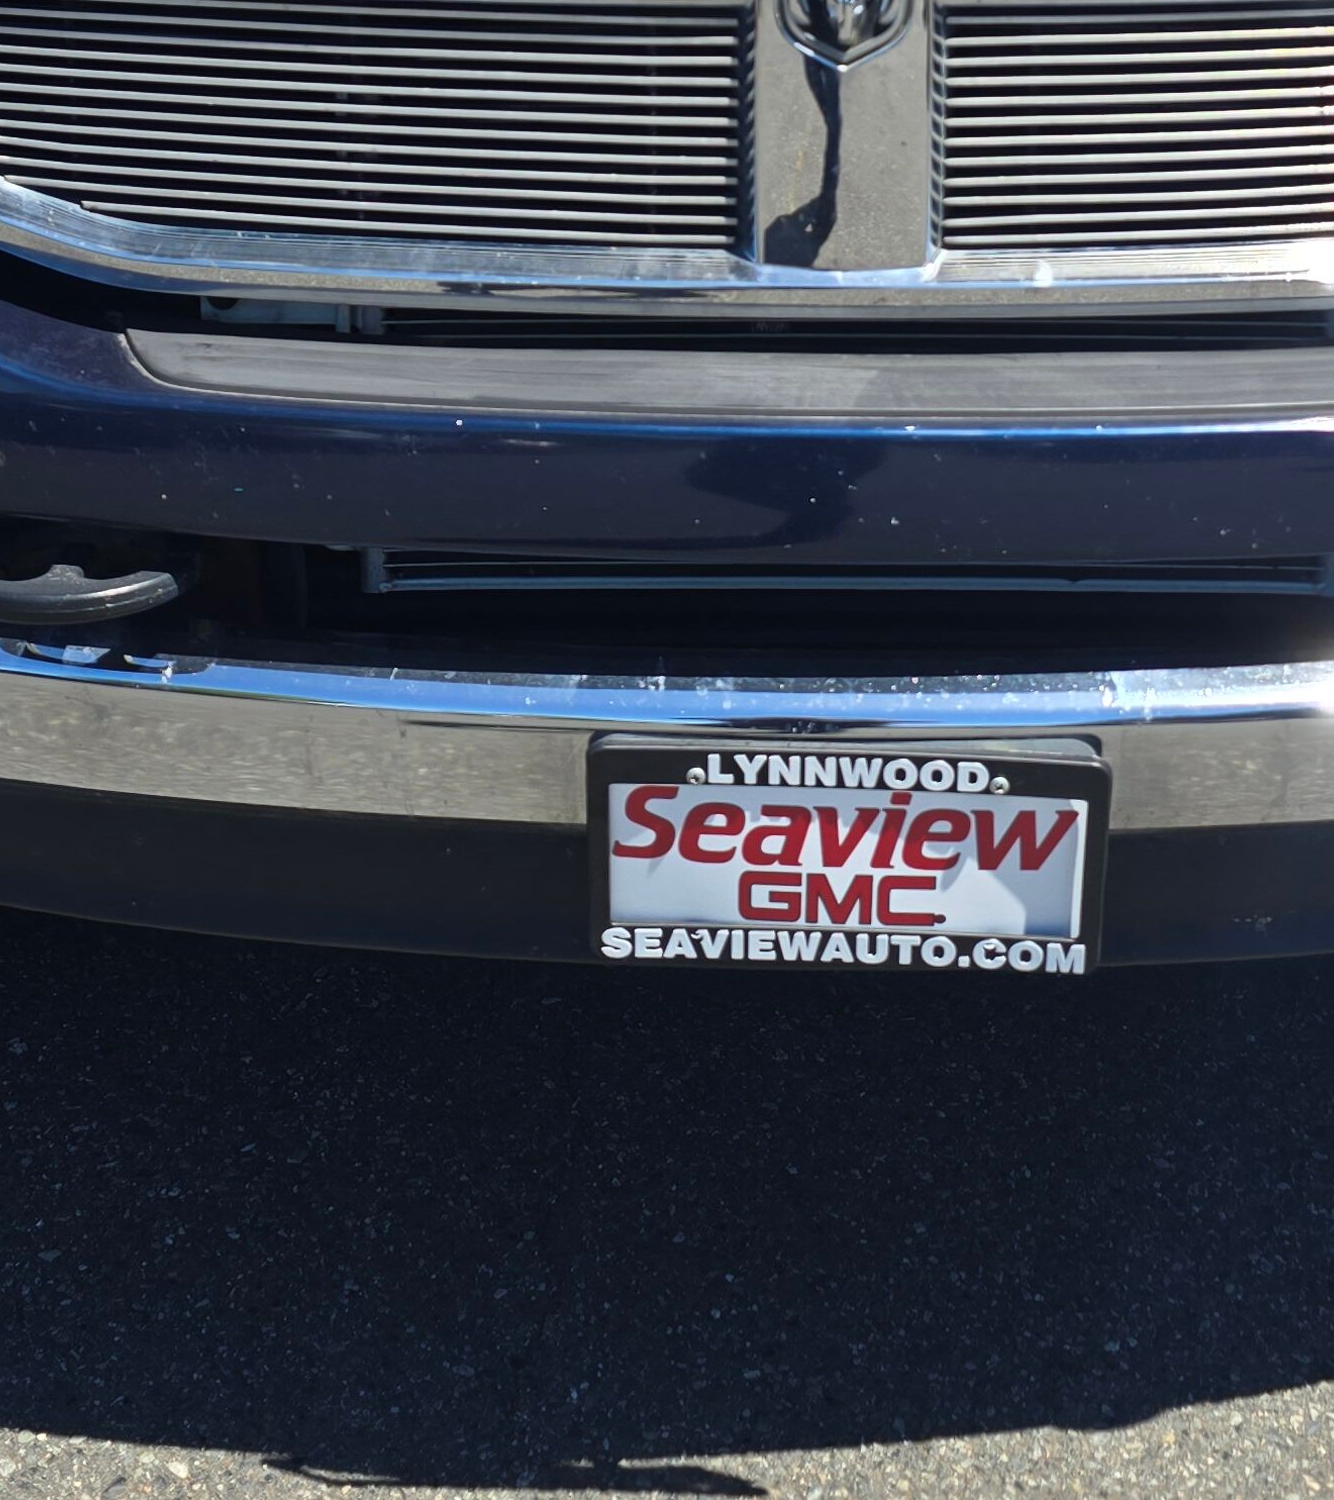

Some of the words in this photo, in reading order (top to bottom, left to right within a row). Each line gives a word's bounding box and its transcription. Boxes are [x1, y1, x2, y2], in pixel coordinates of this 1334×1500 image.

[706, 753, 990, 794] LYNNWOOD
[612, 784, 1079, 871] Seaview
[738, 871, 939, 926] GMC
[601, 927, 1086, 975] SEAVIEWAUTO.COM
